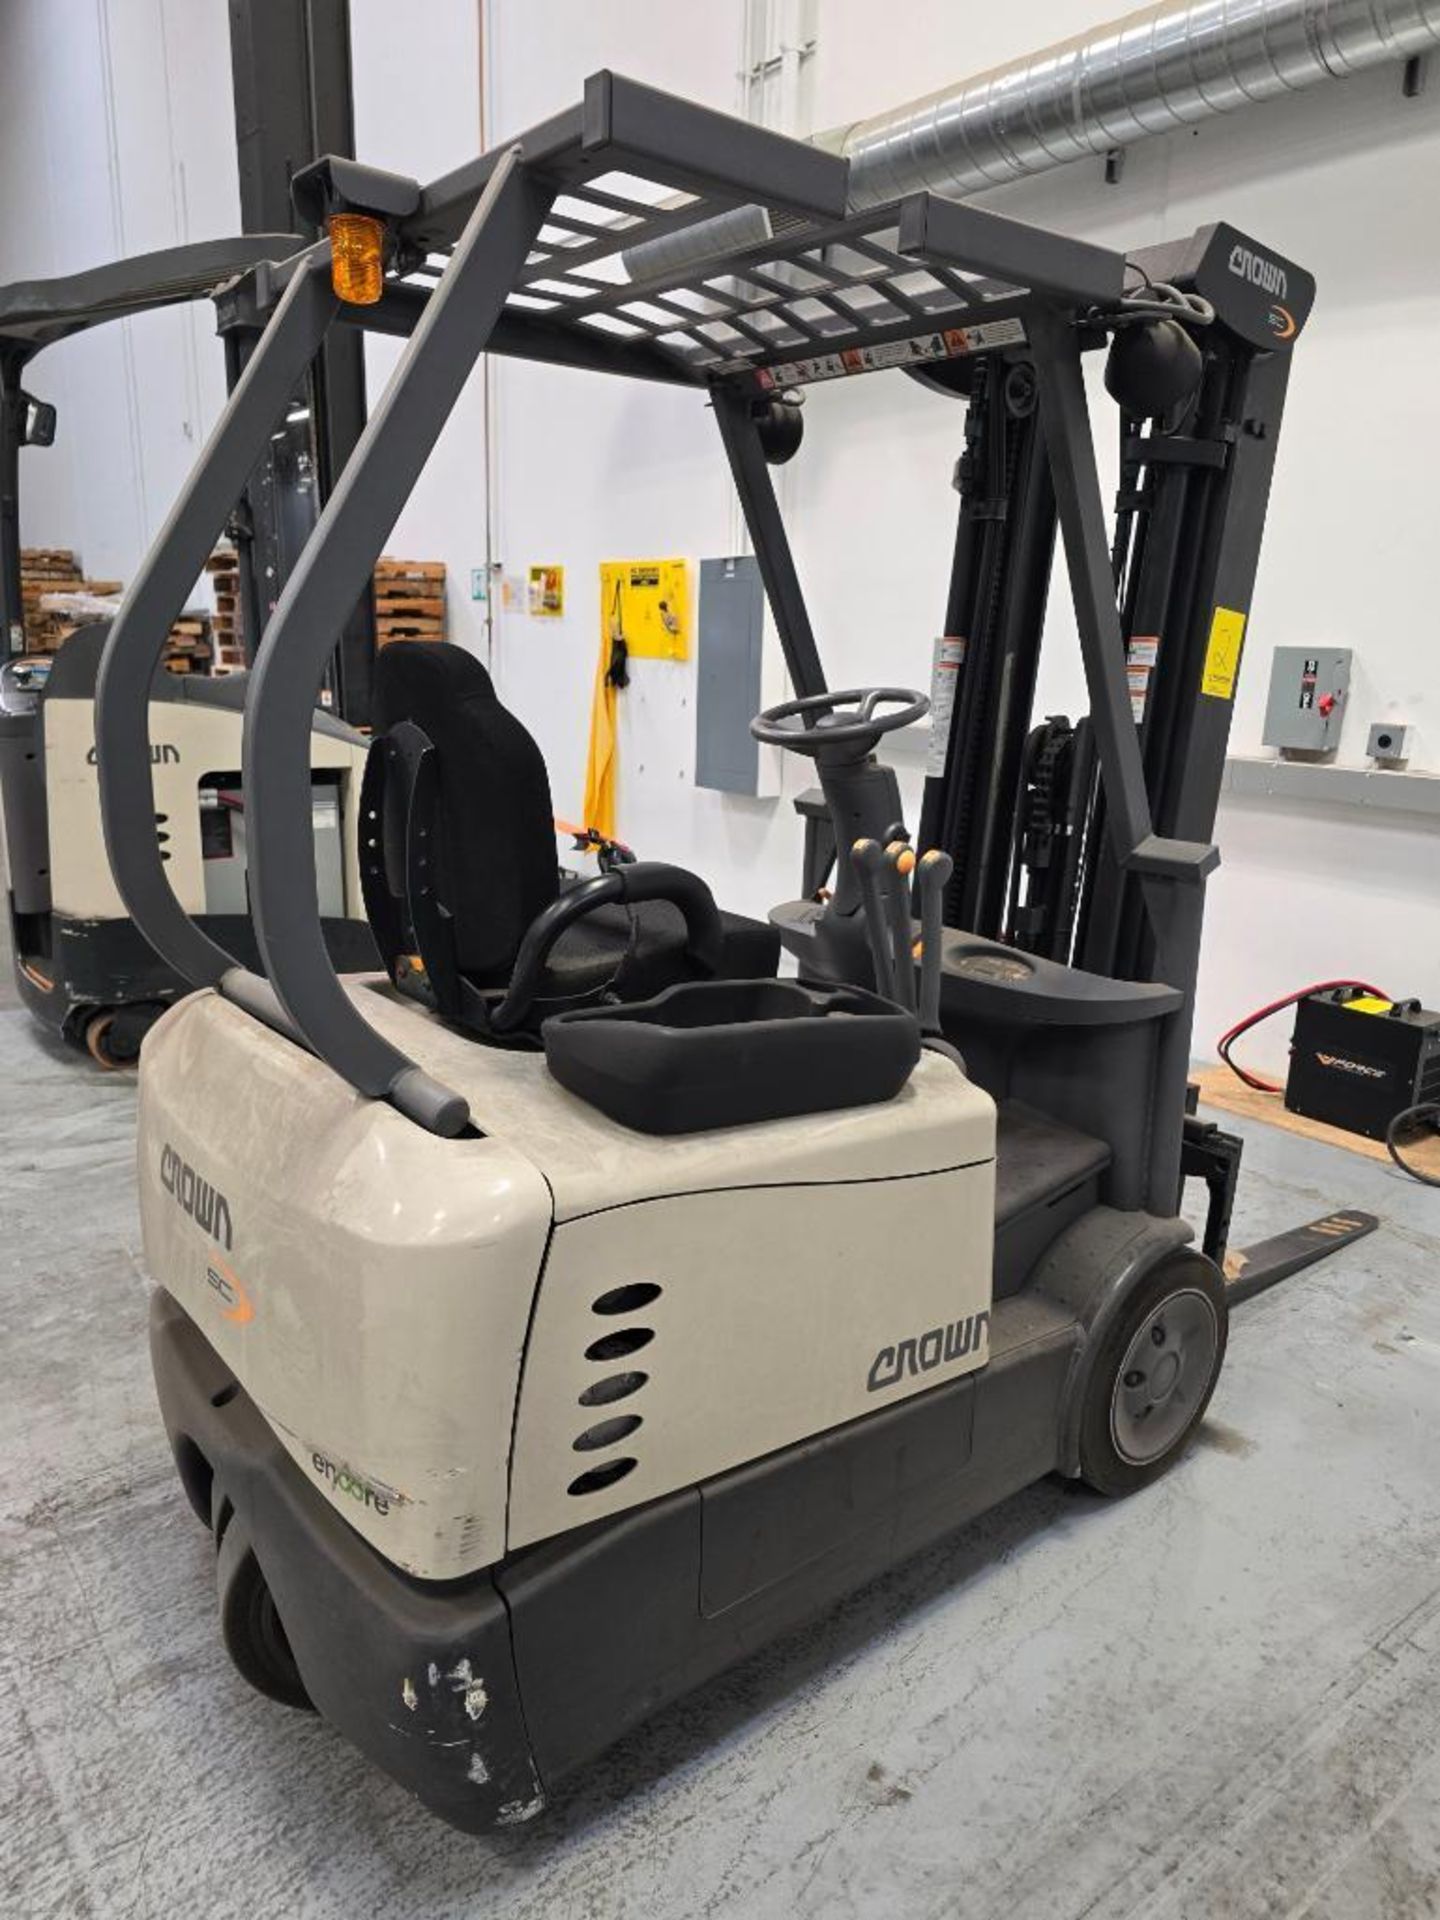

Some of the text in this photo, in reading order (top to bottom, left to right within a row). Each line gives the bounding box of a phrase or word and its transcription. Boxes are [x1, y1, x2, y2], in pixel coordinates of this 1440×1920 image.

[1228, 245, 1287, 300] CROWN
[161, 1143, 232, 1251] CROWN
[867, 1310, 990, 1392] CROWN
[311, 1452, 390, 1516] encore
